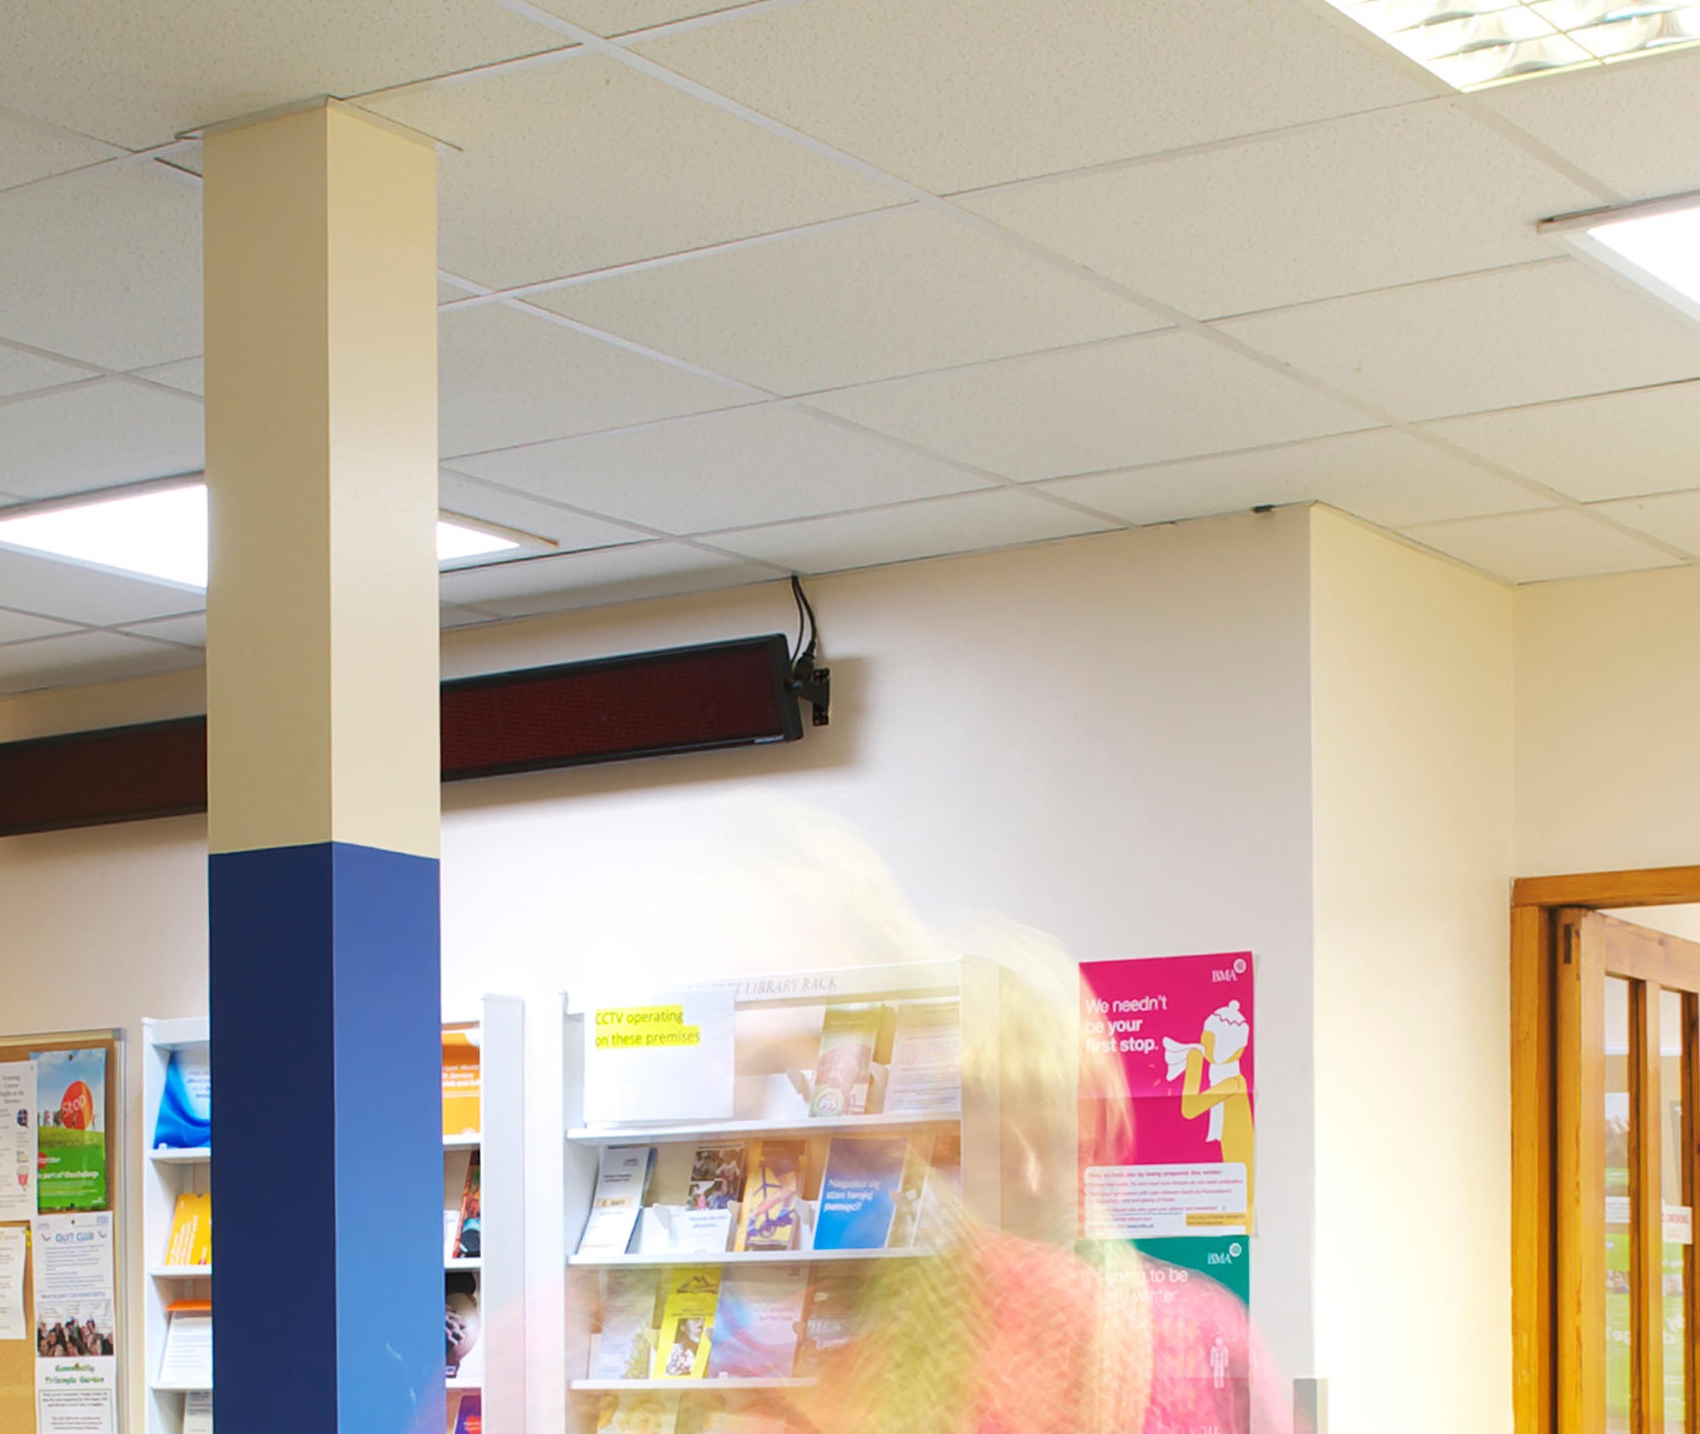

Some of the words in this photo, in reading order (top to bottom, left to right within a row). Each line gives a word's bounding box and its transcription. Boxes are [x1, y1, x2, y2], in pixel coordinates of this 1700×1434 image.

[1212, 969, 1238, 982] BMA
[745, 979, 798, 995] LIBRARY
[802, 975, 837, 991] RACK
[1085, 998, 1109, 1013] We
[1112, 995, 1168, 1013] needn't
[595, 1012, 624, 1026] CCTV
[626, 1009, 684, 1026] operating
[1085, 1020, 1104, 1034] be
[1107, 1019, 1143, 1036] your
[595, 1036, 609, 1047] on
[611, 1032, 643, 1045] these
[646, 1031, 701, 1045] premises
[1085, 1038, 1117, 1053] first
[1120, 1036, 1159, 1053] stop.
[1207, 1252, 1232, 1264] BMA
[1150, 1269, 1165, 1283] to
[1169, 1268, 1188, 1282] be
